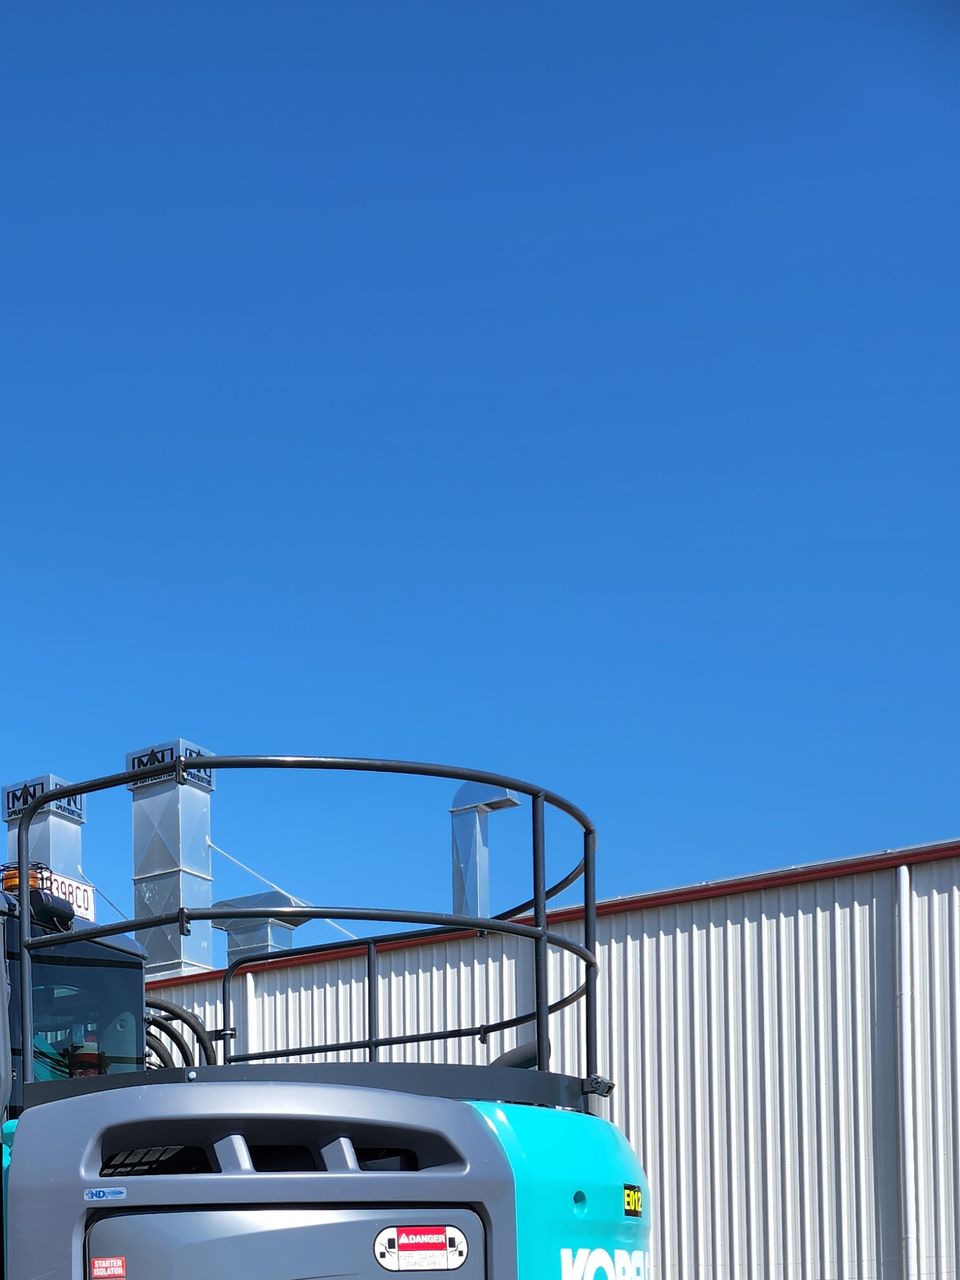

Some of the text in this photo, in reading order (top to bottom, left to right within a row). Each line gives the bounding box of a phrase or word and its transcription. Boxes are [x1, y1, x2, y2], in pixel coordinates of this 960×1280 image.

[624, 1189, 642, 1211] E012
[408, 1234, 446, 1243] DANGER
[94, 1260, 122, 1268] STARTER
[94, 1267, 123, 1275] ISOLATOR
